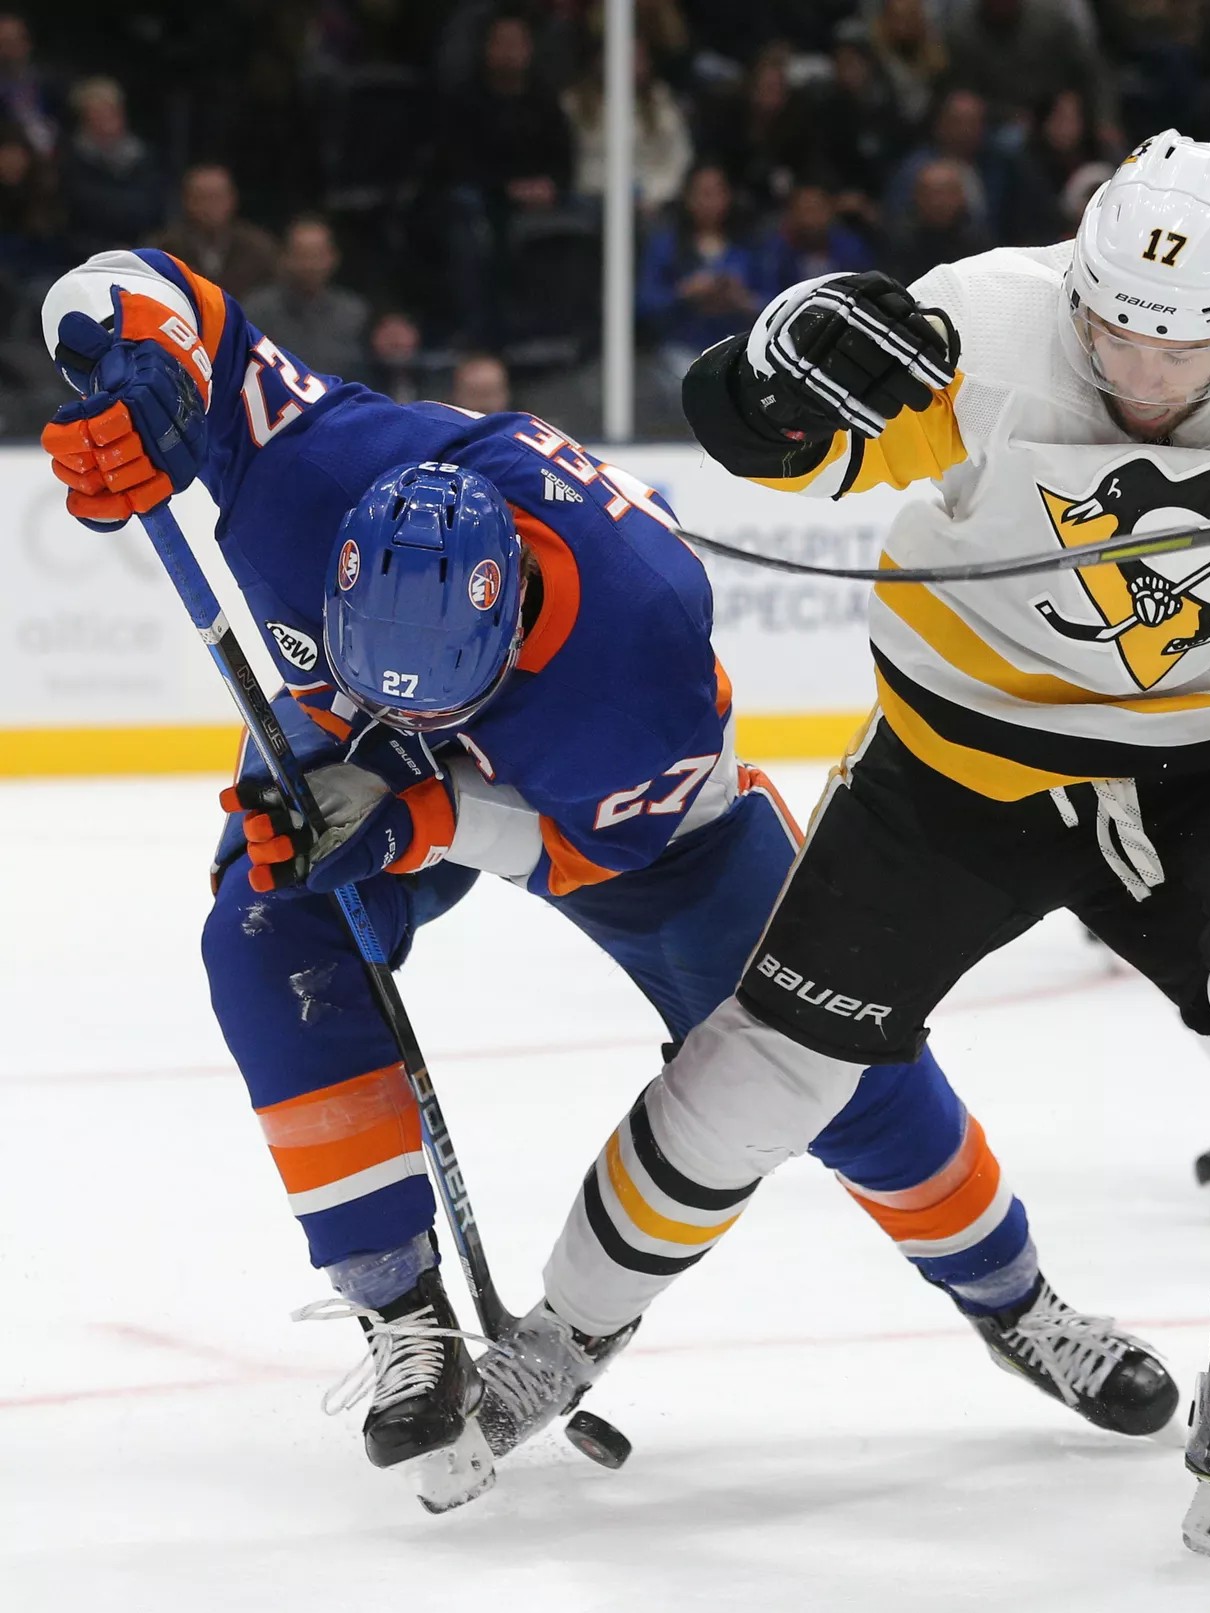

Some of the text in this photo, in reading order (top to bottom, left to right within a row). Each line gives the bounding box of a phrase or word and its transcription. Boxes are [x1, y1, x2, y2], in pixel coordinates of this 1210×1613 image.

[1142, 228, 1188, 267] 17
[240, 335, 328, 448] 27
[540, 467, 584, 503] adidas
[269, 626, 316, 666] CBW
[382, 669, 419, 698] 27
[593, 753, 721, 831] 27
